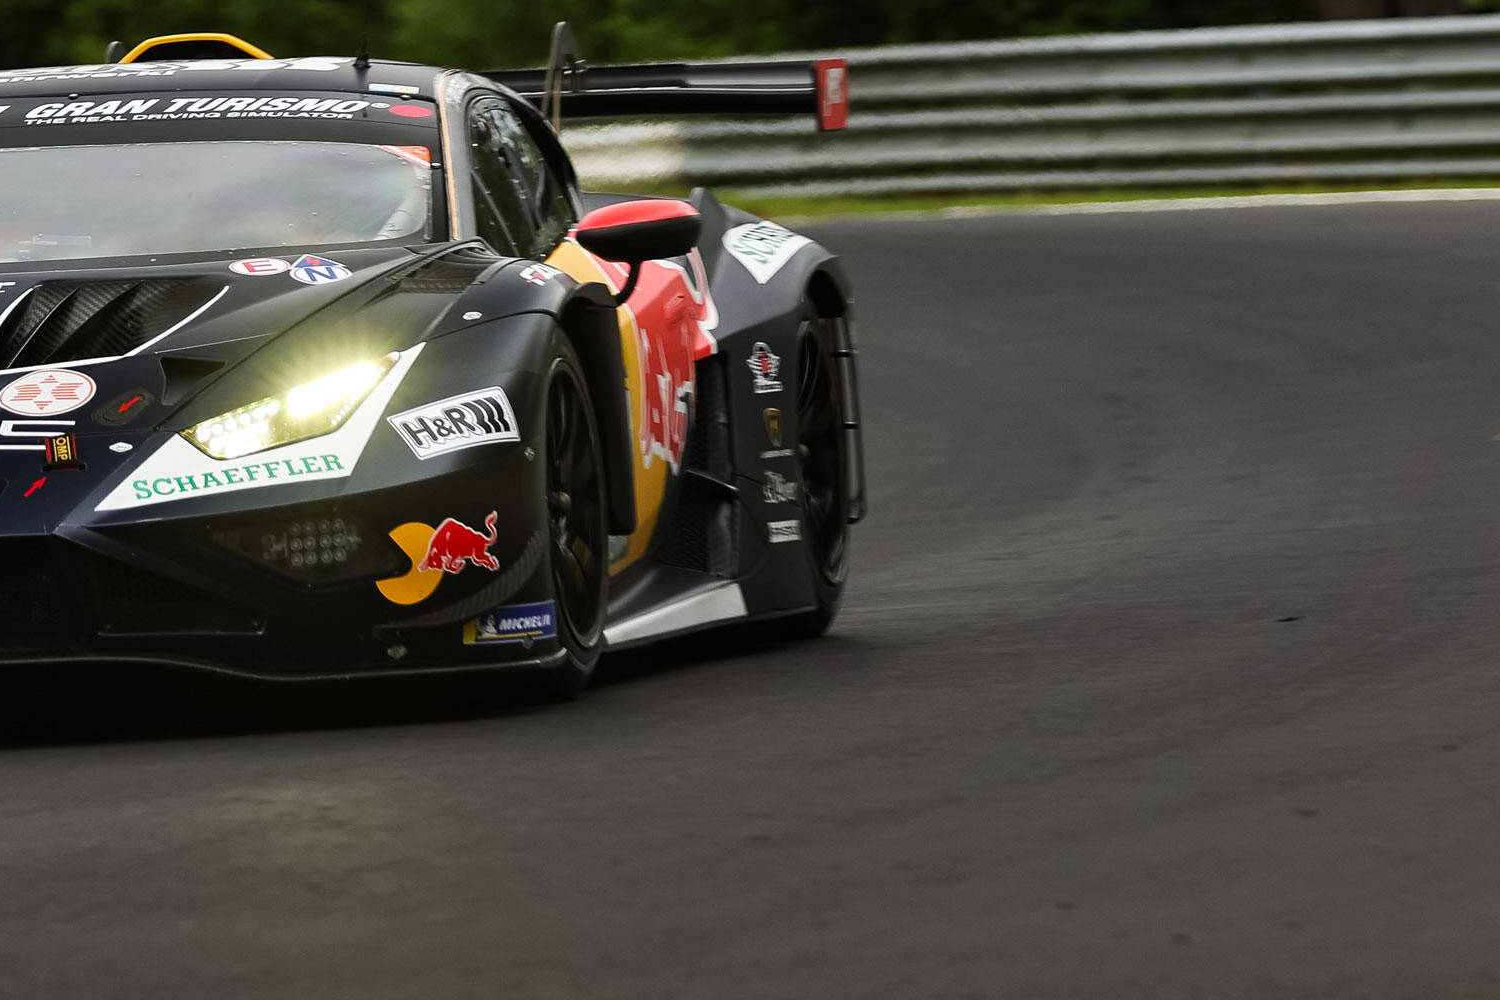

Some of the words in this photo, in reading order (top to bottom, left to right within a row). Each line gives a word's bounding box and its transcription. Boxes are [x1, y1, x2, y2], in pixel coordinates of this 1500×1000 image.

[24, 118, 66, 126] THE
[71, 114, 126, 123] REAL
[132, 111, 219, 120] DRIVING
[226, 110, 354, 119] SIMULATOR
[25, 99, 160, 119] GRAN
[56, 437, 68, 460] OMP
[133, 454, 345, 500] SCHAEFFLER
